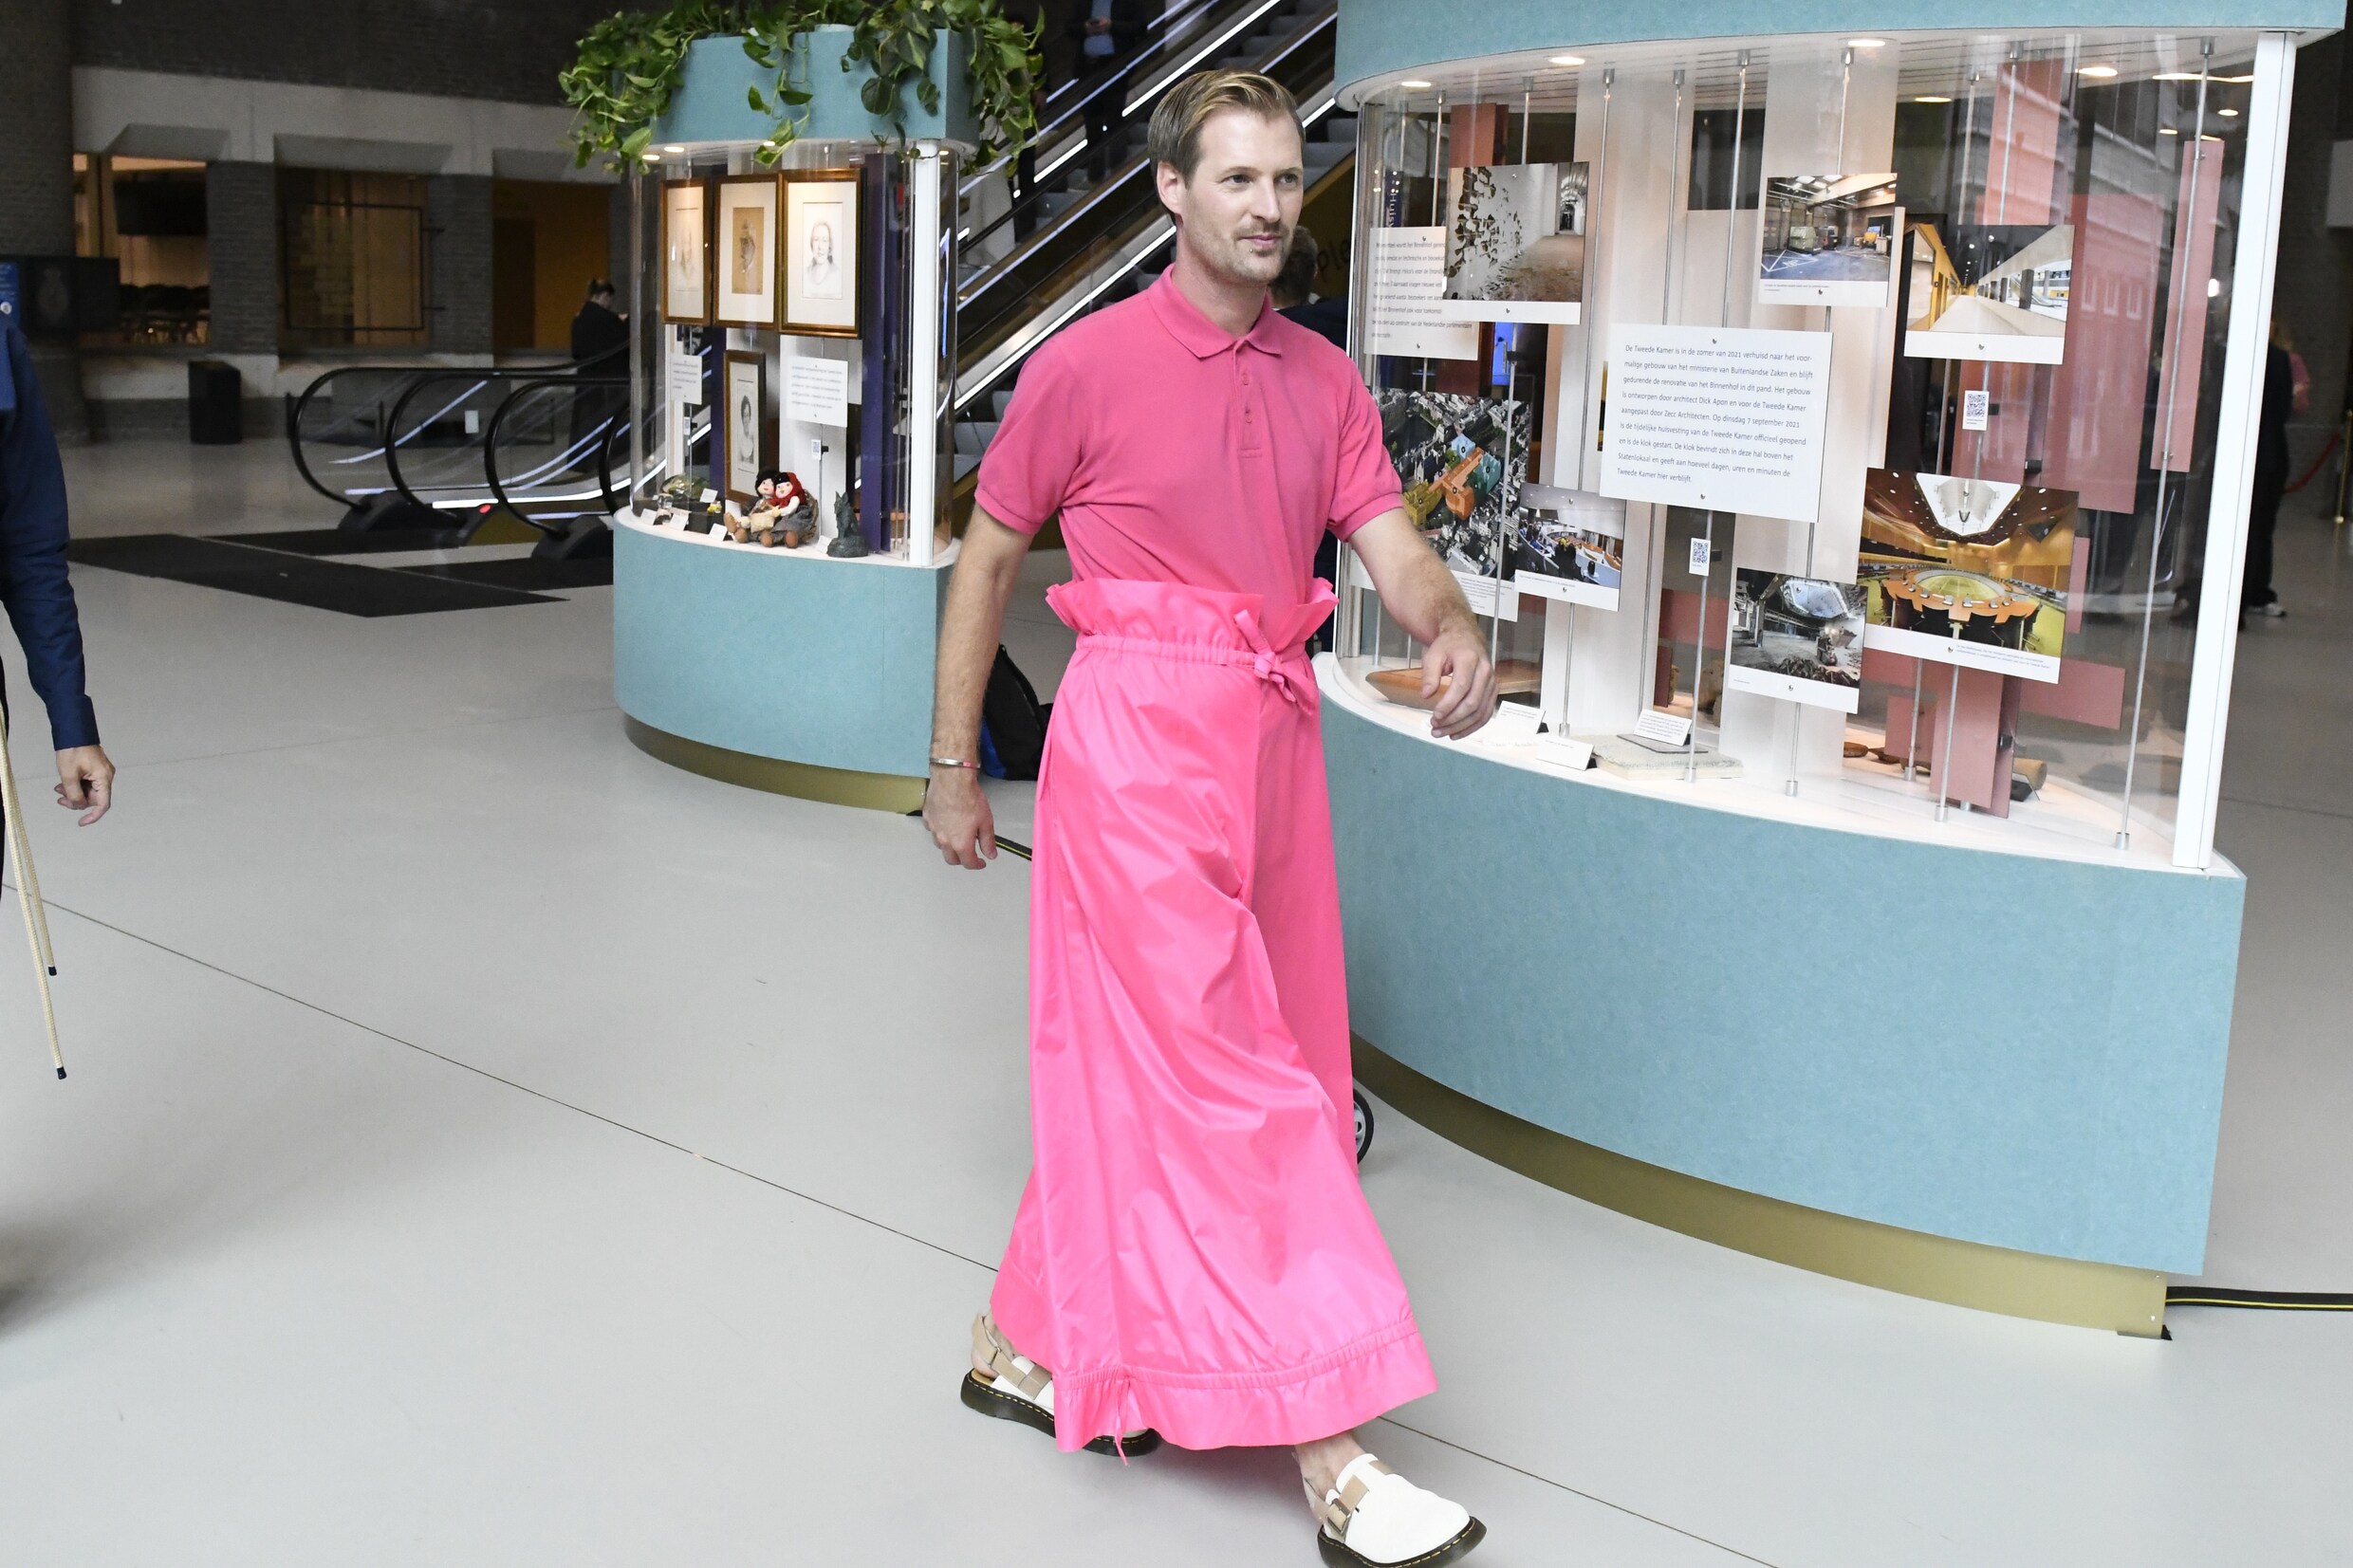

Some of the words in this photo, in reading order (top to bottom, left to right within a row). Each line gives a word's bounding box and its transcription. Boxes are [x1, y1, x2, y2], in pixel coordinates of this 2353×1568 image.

[1731, 366, 1769, 376] Buitenlandse
[1798, 371, 1813, 379] blijft
[1709, 381, 1739, 390] Binnenhof
[1713, 397, 1728, 406] Apon
[1762, 401, 1785, 410] Tweede
[1677, 411, 1710, 419] Architecten.
[1712, 414, 1721, 422] Op
[1722, 415, 1745, 425] dinsdag
[1633, 423, 1657, 432] tijdelijke
[1658, 425, 1689, 435] huisvesting
[1711, 430, 1732, 438] Tweede
[1733, 432, 1752, 440] Kamer
[1753, 434, 1778, 442] officieel
[1618, 452, 1651, 462] Statenlokaal
[1687, 459, 1710, 468] hoeveel
[1711, 462, 1731, 471] dagen,
[1763, 451, 1781, 459] boven
[1617, 468, 1637, 476] Tweede
[1669, 474, 1691, 483] verblijft.
